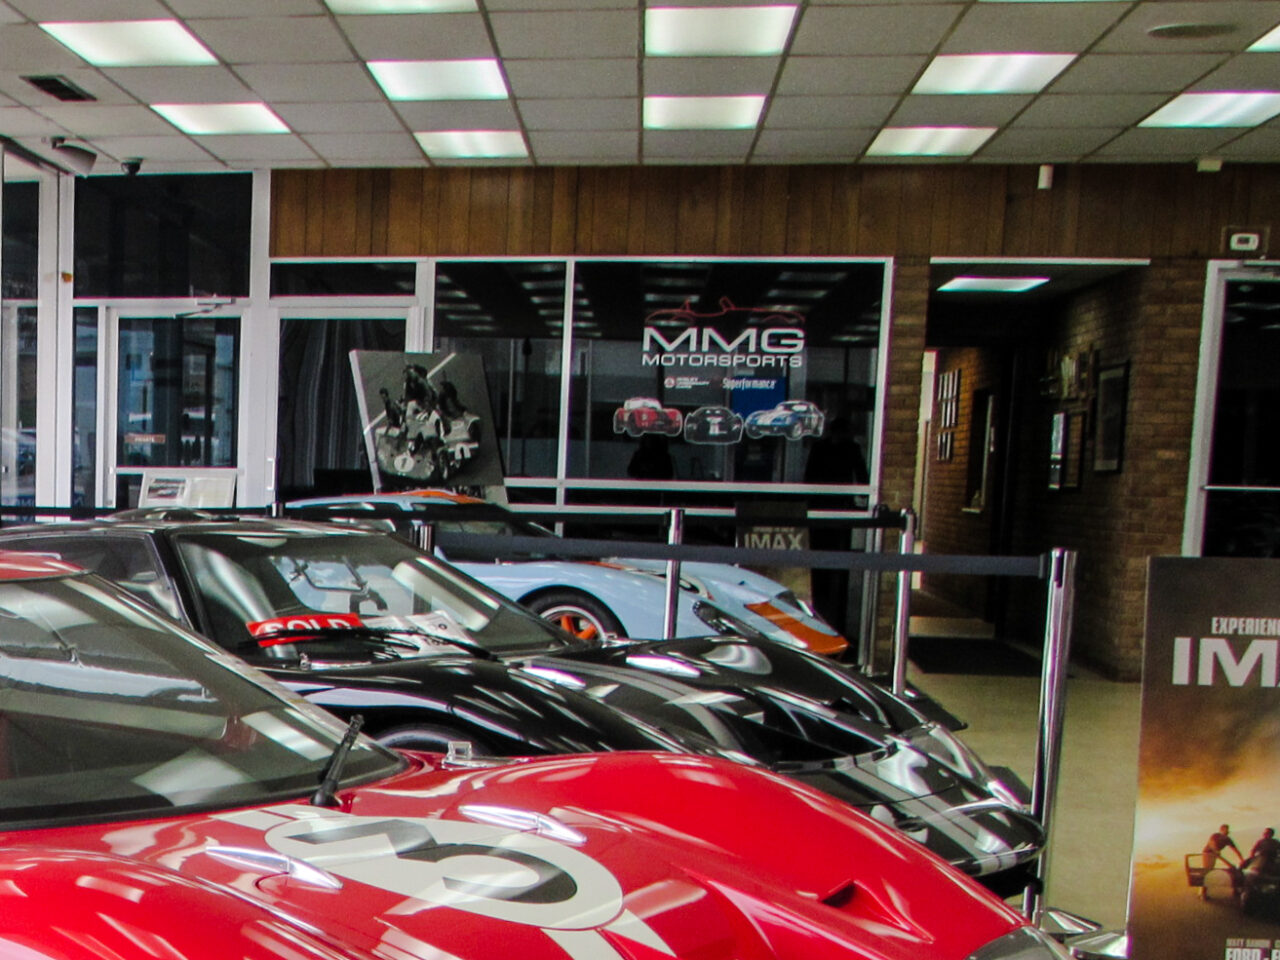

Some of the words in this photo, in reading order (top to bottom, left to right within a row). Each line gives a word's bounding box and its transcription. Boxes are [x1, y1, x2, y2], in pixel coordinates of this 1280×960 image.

[642, 327, 805, 353] MMG
[642, 353, 802, 367] MOTORSPORTS
[744, 533, 803, 550] IMAX
[1172, 637, 1280, 687] IM
[284, 819, 578, 904] 3
